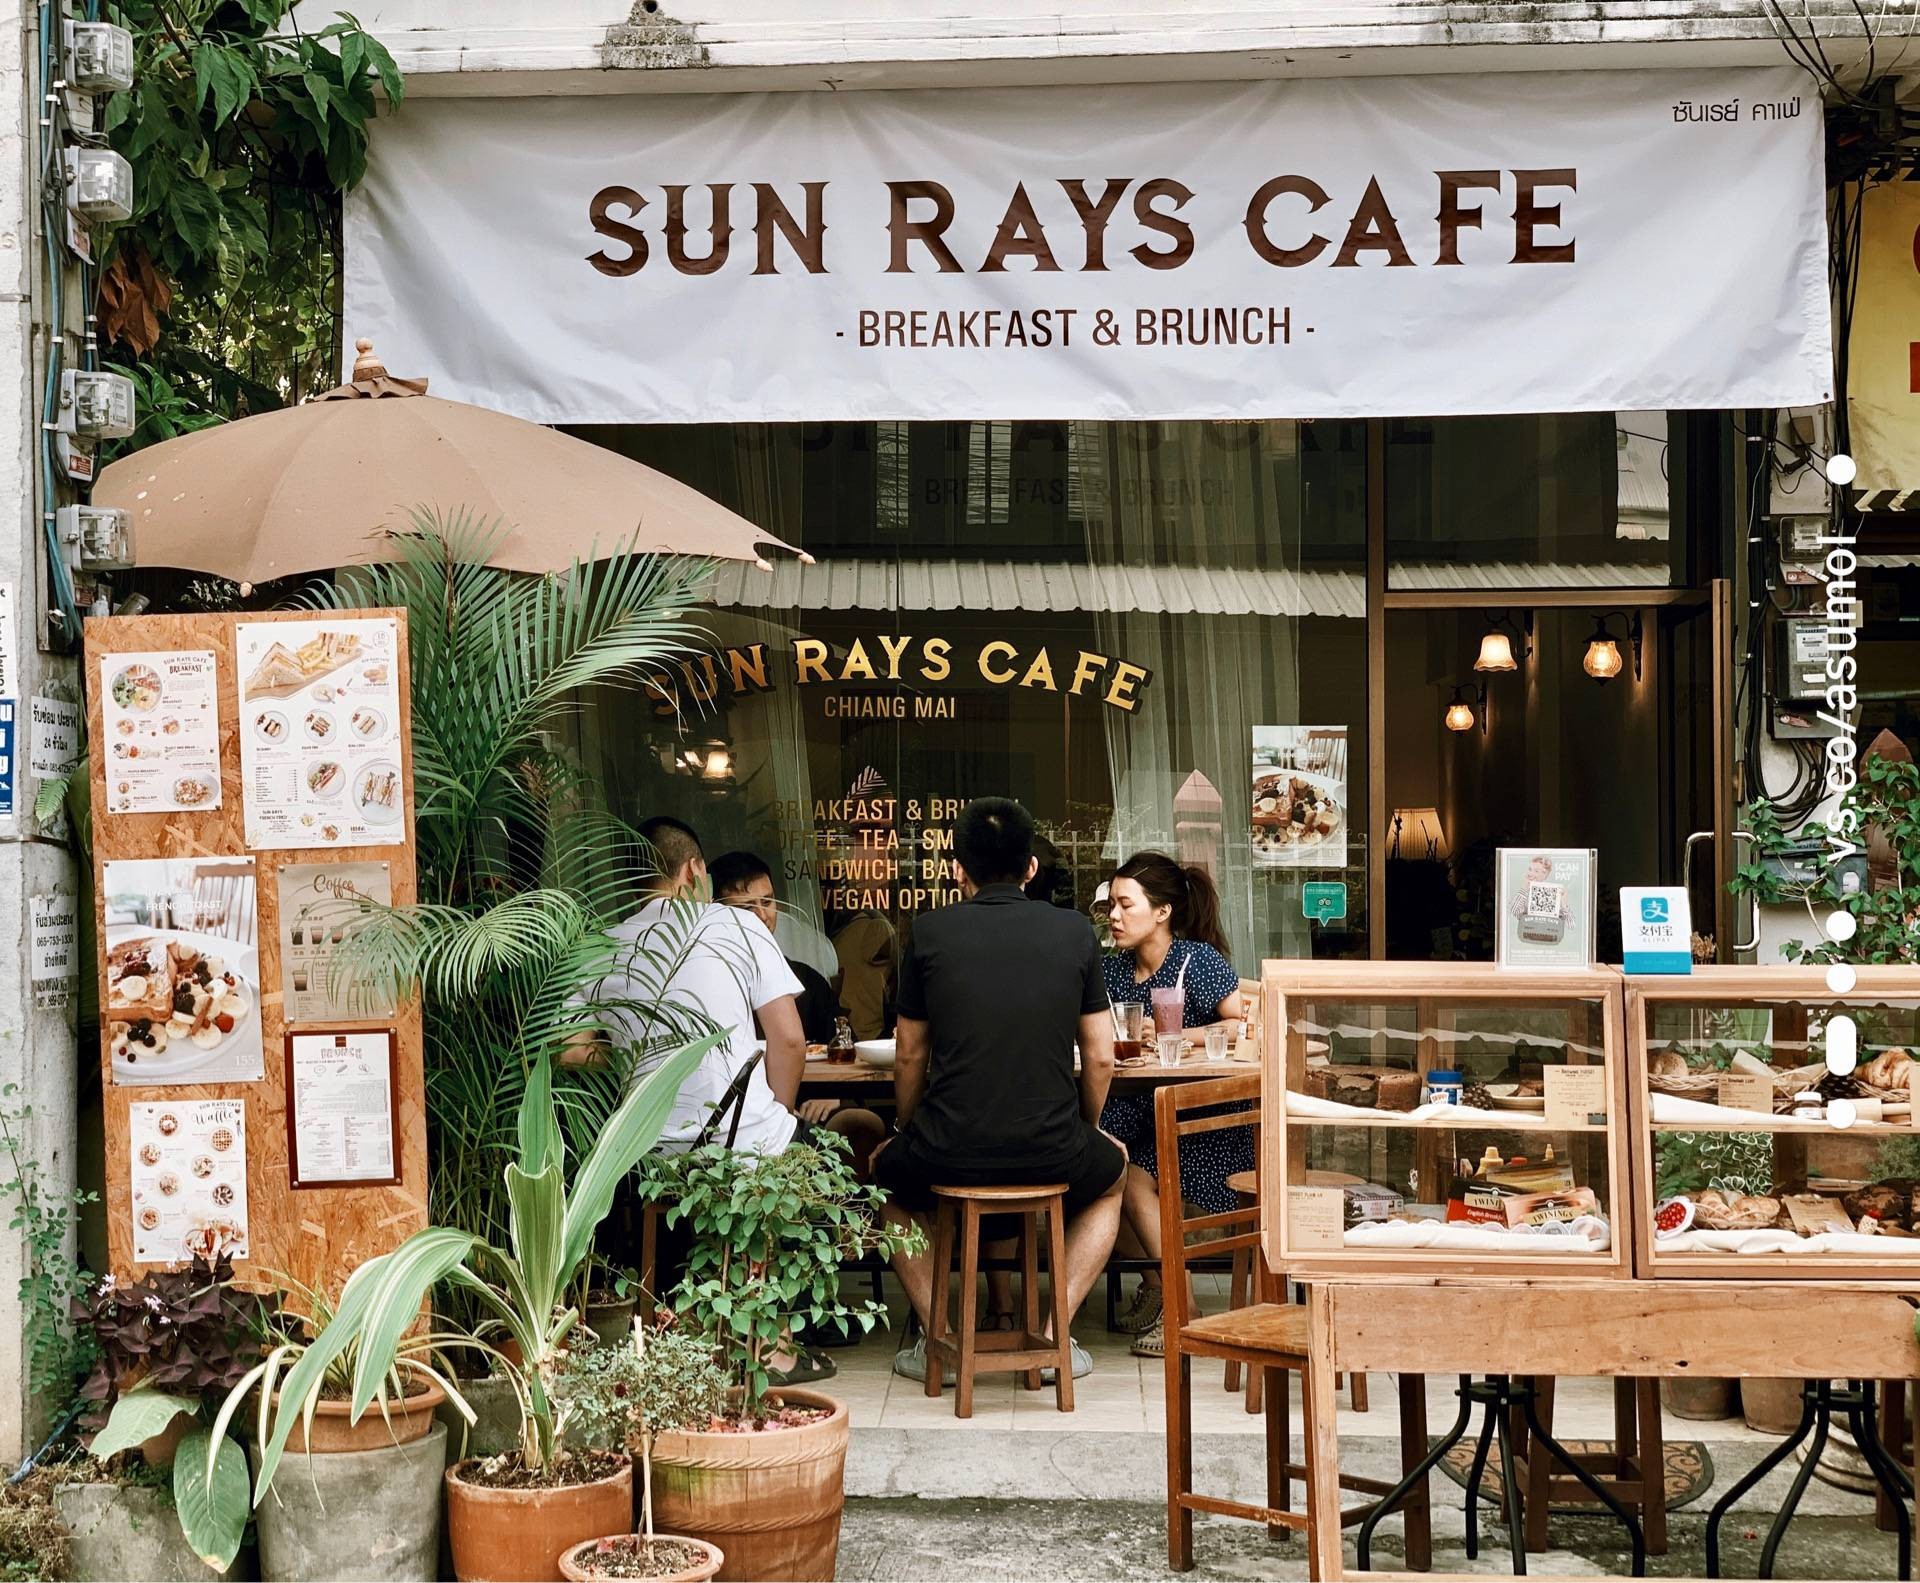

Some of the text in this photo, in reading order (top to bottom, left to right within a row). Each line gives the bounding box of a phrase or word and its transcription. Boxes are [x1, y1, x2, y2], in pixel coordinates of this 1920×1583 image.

[1752, 96, 1800, 121] คาเฟ่
[584, 168, 1577, 277] SUN RAYS CAFE
[859, 309, 1077, 348] BREAKFAST
[1092, 308, 1121, 346] &
[1136, 307, 1291, 346] BRUNCH
[644, 635, 1149, 717] SUN RAYS CAFE
[824, 696, 956, 718] CHIANG MAI
[906, 799, 923, 821] &
[859, 829, 900, 850] TEA
[784, 859, 898, 881] SANDWICH
[821, 888, 963, 910] VEGAN OPTIO
[1640, 925, 1673, 937] 支付宝
[1531, 1209, 1574, 1223] TWININGS
